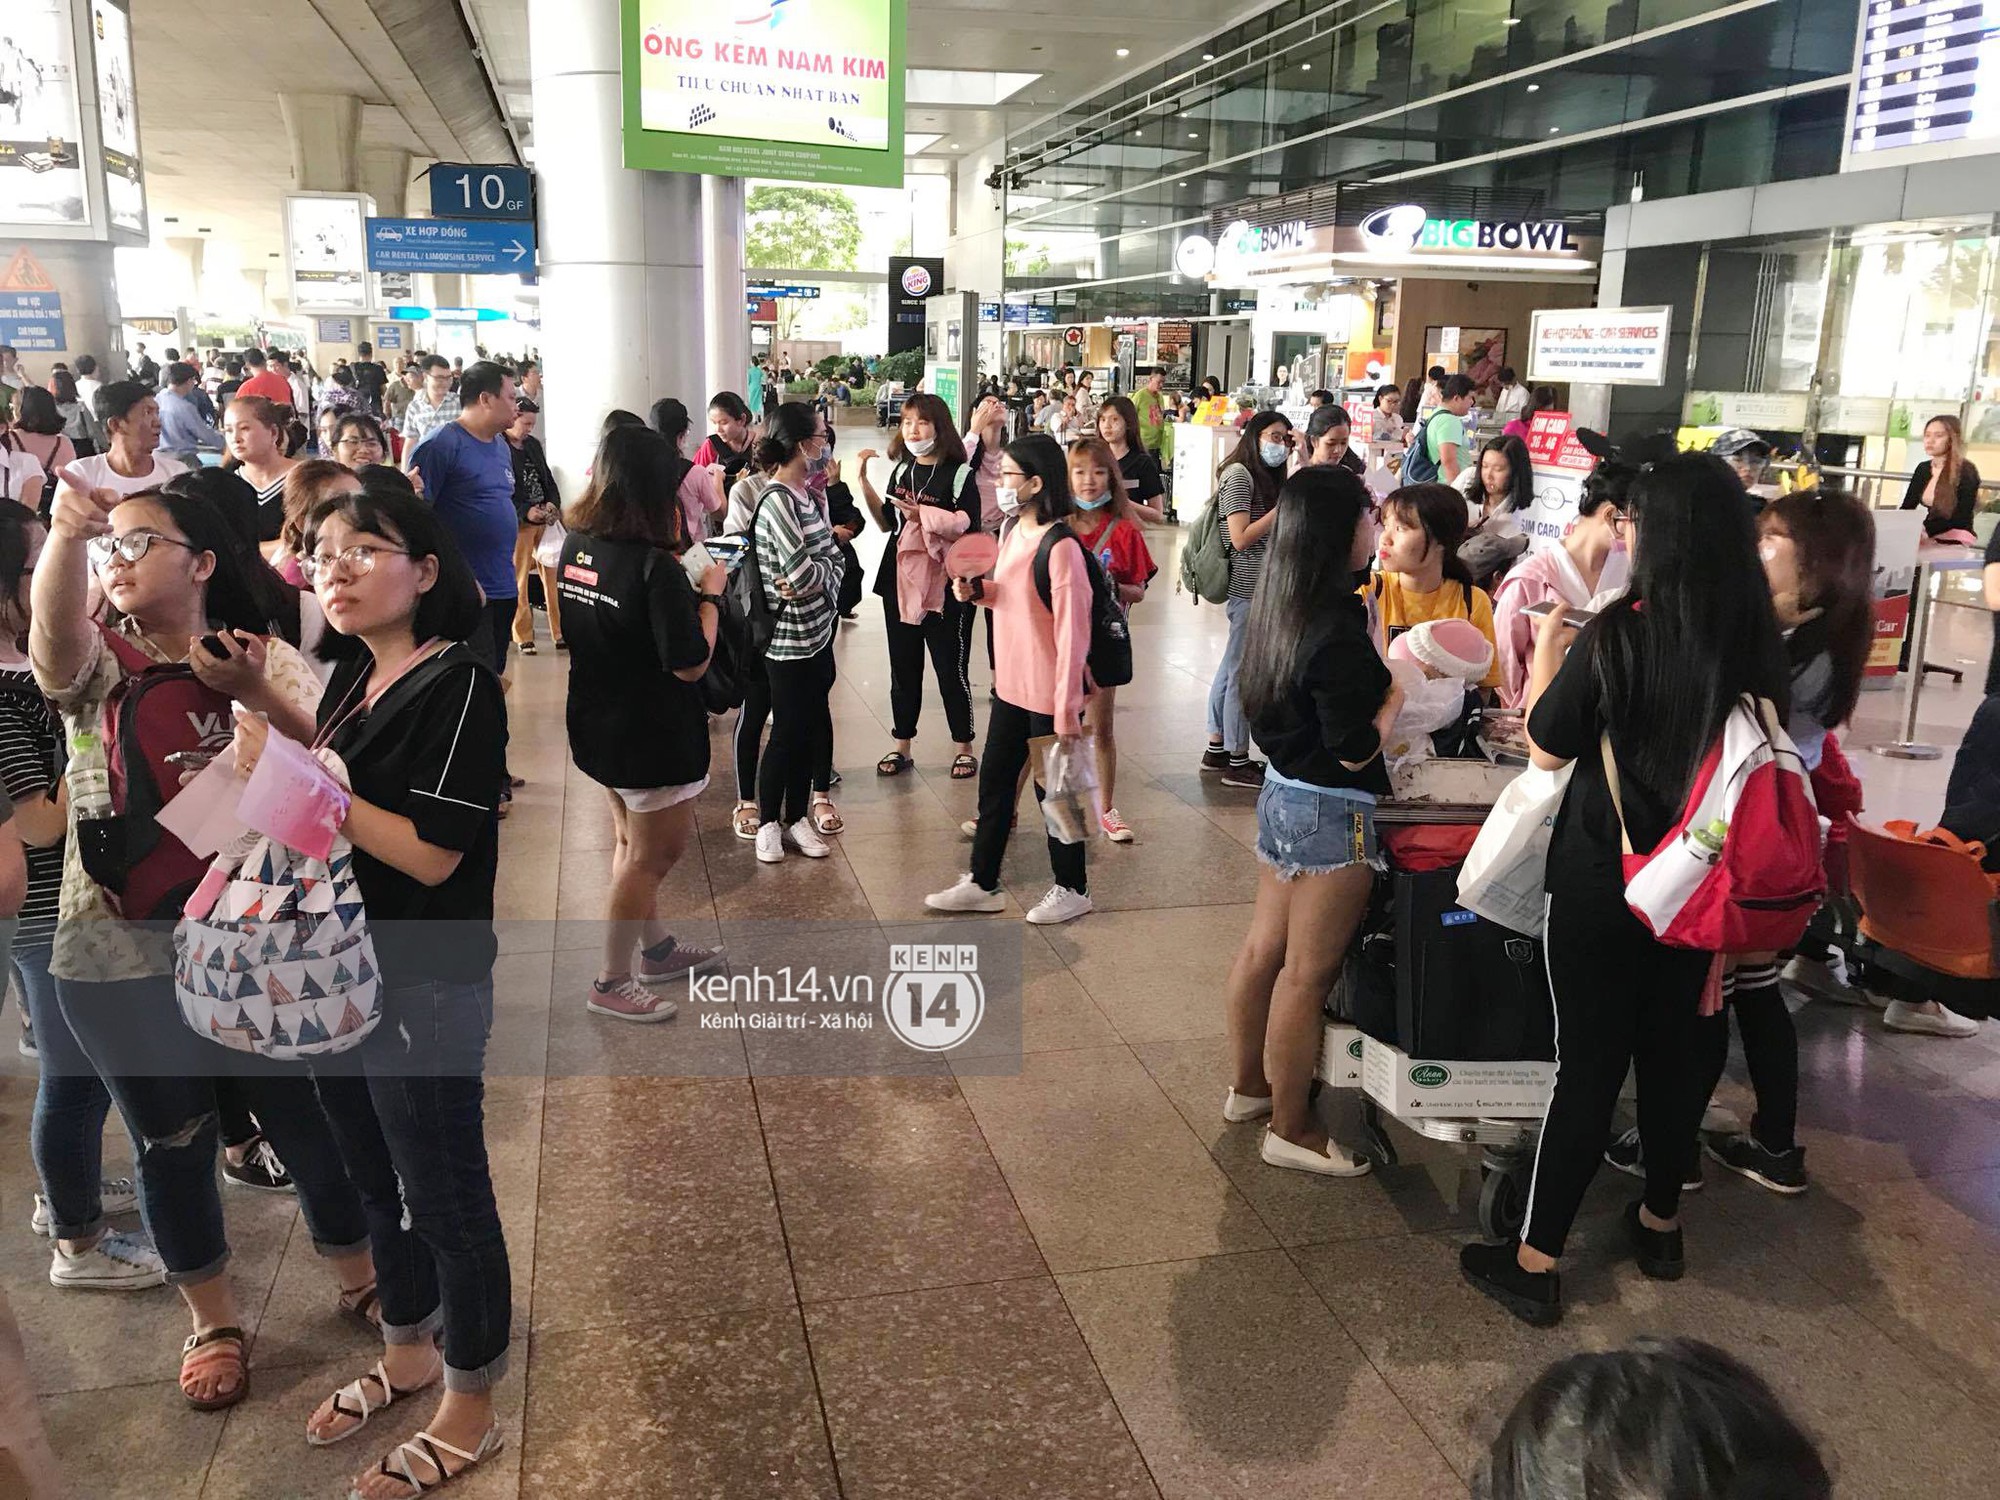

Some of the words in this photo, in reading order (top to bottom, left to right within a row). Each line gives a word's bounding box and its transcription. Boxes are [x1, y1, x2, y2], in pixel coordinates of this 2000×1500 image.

[778, 49, 833, 74] NAM
[843, 57, 886, 80] KIM
[456, 173, 505, 210] 10
[506, 200, 524, 210] GF
[405, 226, 416, 236] XE
[375, 250, 390, 258] CAR
[391, 251, 419, 260] RENTAL
[425, 253, 465, 261] LIMOUSINE
[467, 254, 495, 262] SERVICE
[907, 276, 928, 289] KING
[1521, 519, 1535, 534] SIM
[1537, 522, 1560, 539] CARD
[1877, 619, 1898, 632] Car
